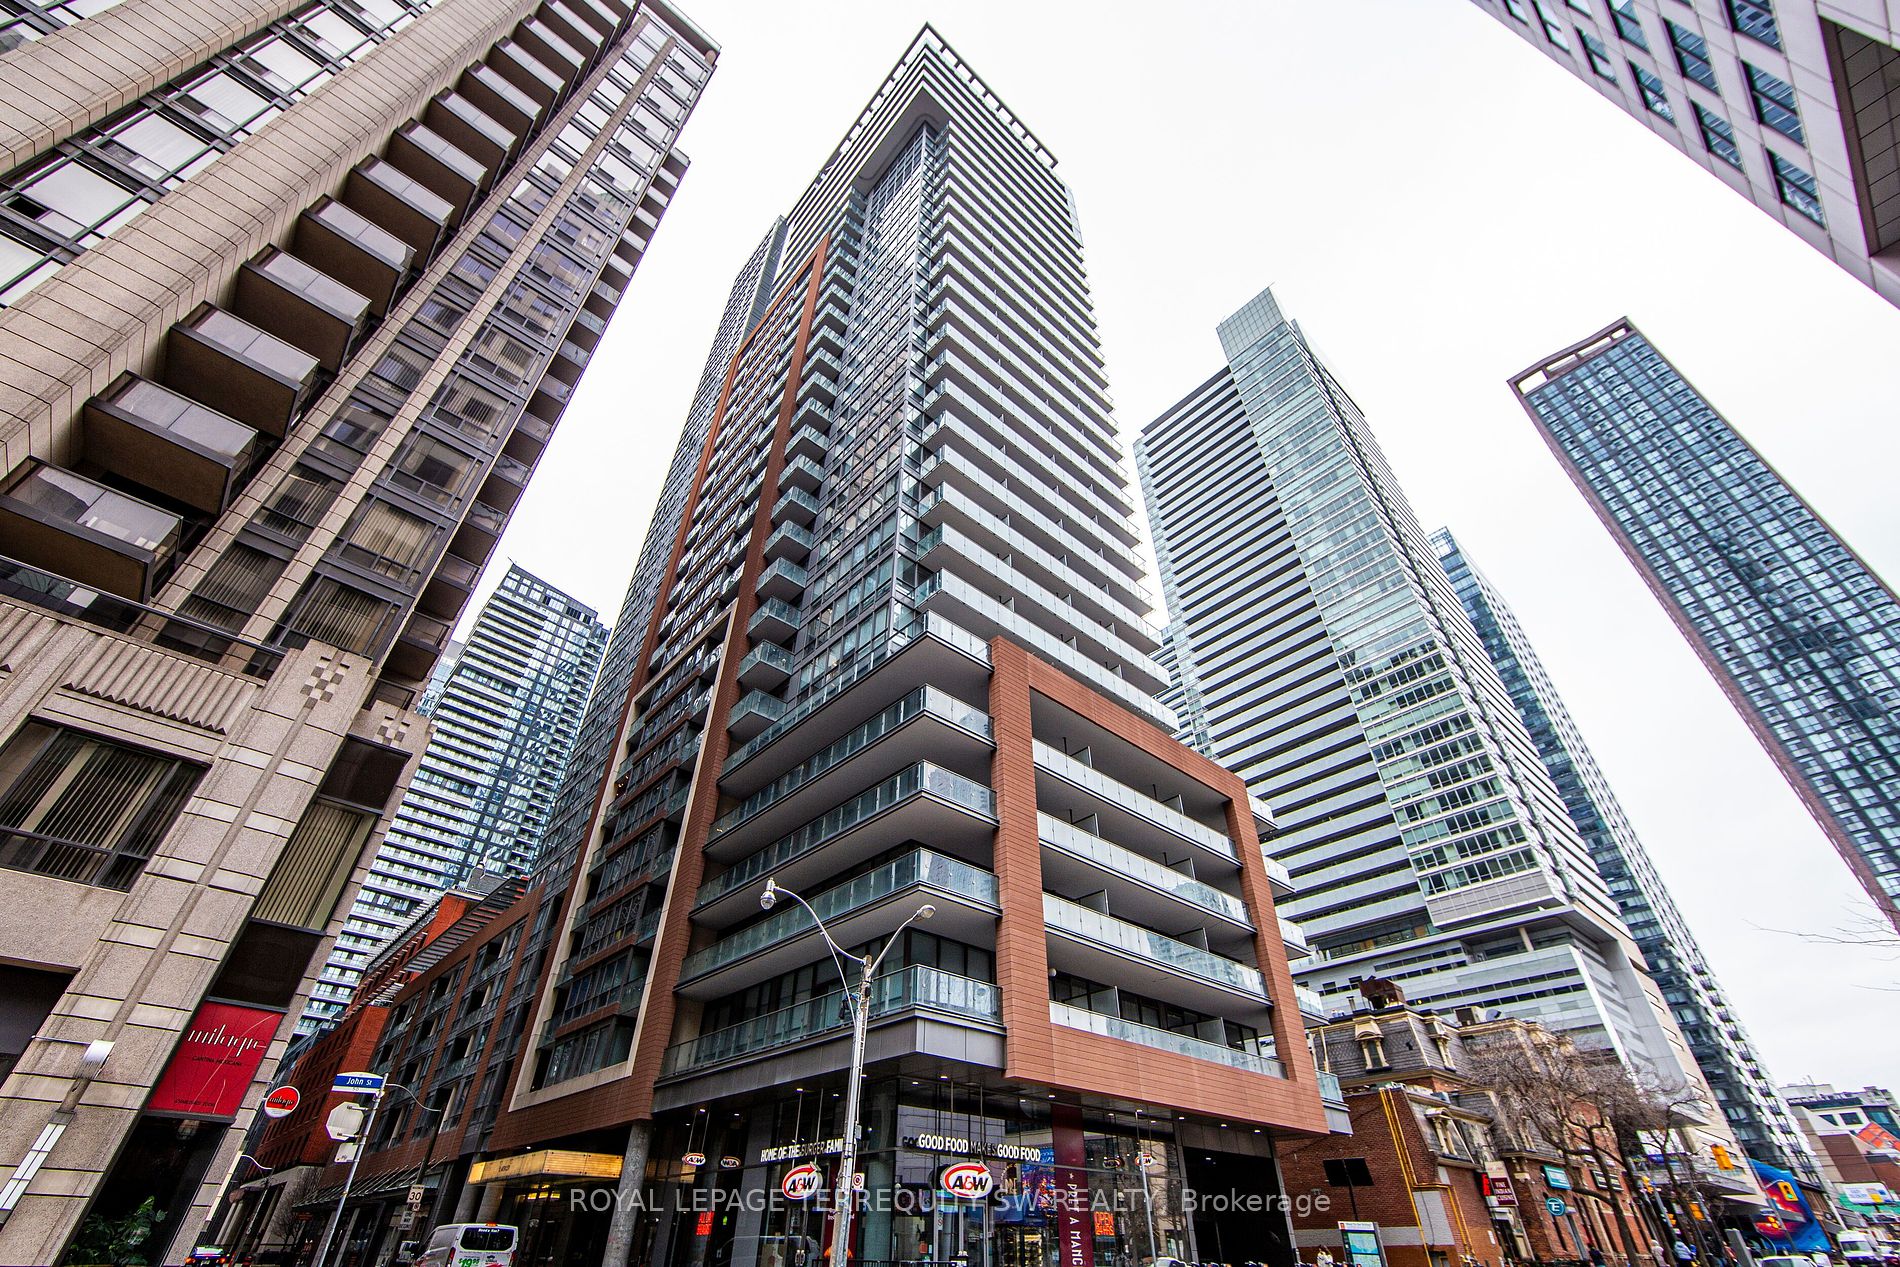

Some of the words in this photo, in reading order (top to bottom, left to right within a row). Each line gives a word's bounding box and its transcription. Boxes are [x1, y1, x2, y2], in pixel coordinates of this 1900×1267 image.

[346, 1077, 363, 1085] John
[760, 1147, 778, 1162] HOME
[778, 1146, 788, 1159] OF
[788, 1144, 801, 1158] THE
[800, 1141, 825, 1157] BURGER
[826, 1138, 843, 1153] FAMI
[918, 1133, 944, 1150] GOOD
[945, 1137, 969, 1153] FOOD
[970, 1141, 997, 1156] MAKES
[997, 1144, 1019, 1159] GOOD
[1020, 1146, 1041, 1161] FOOD
[688, 1156, 705, 1164] A&W
[788, 1176, 816, 1193] A&W
[952, 1175, 989, 1191] A&W
[409, 1191, 421, 1201] 30
[1067, 1183, 1080, 1212] PRET
[1069, 1217, 1080, 1225] A
